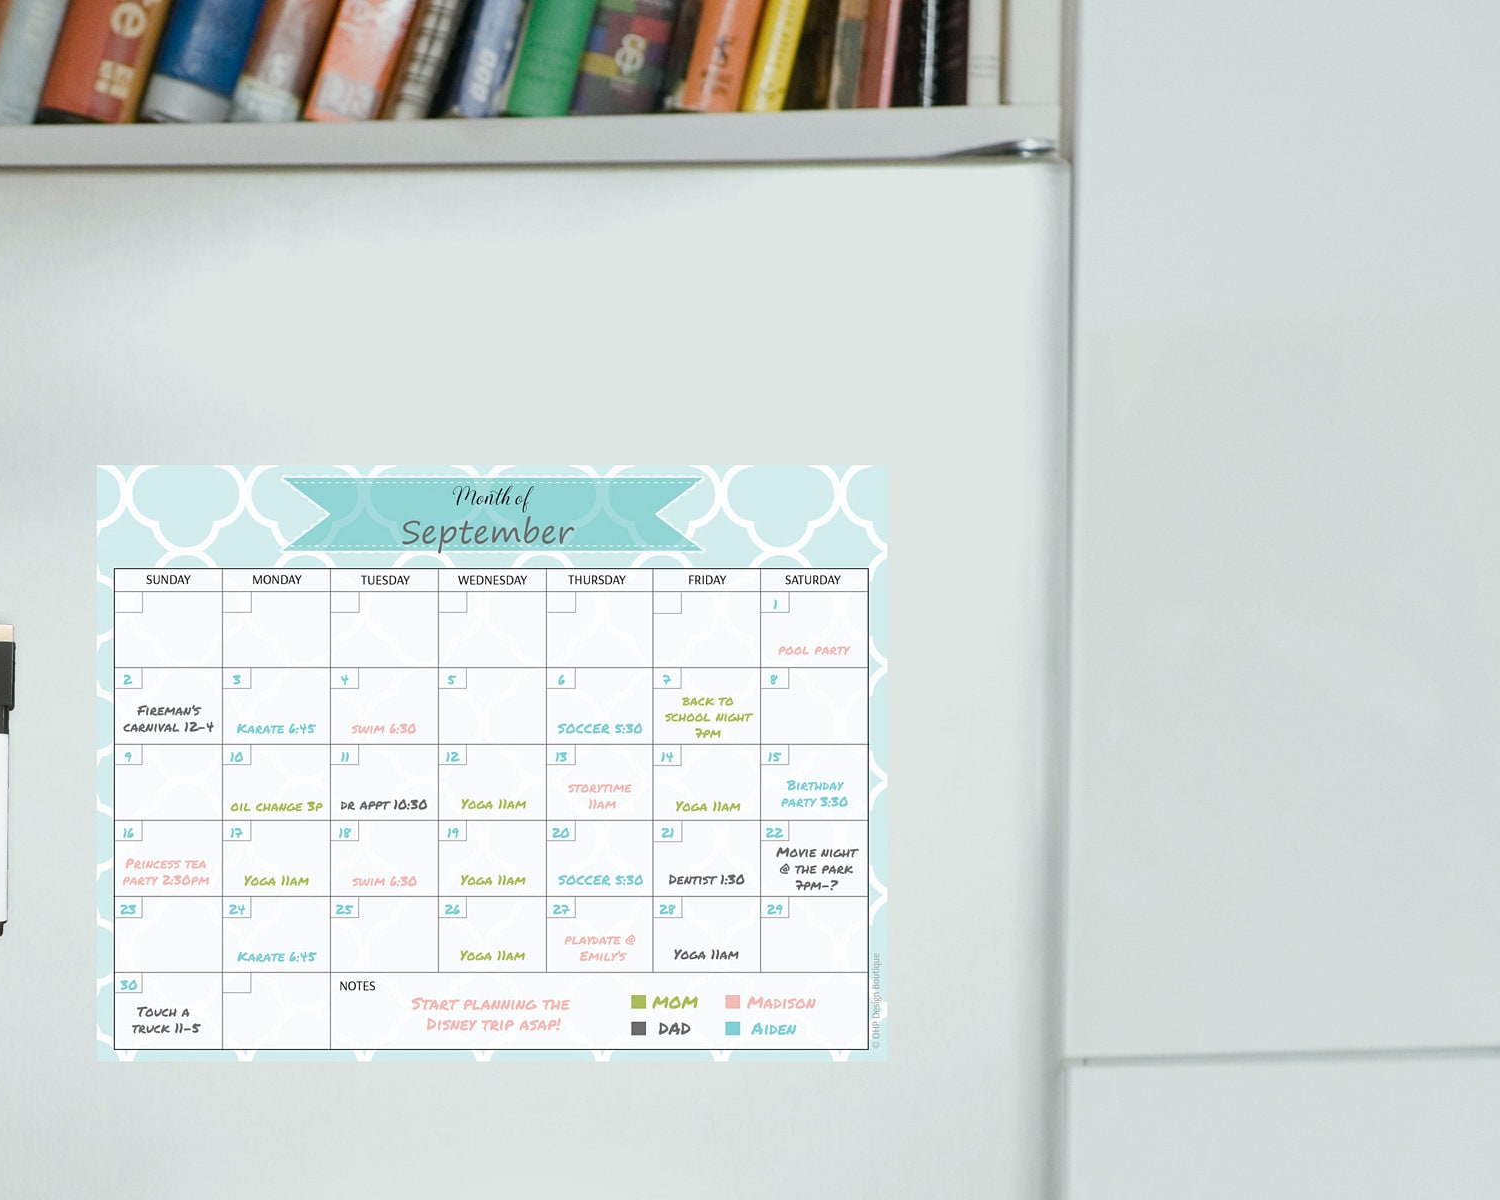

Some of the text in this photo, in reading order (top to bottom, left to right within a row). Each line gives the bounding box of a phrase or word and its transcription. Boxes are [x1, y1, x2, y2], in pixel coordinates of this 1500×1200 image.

[452, 484, 535, 514] Month of
[402, 516, 575, 553] September
[145, 574, 192, 585] SUNDAY
[252, 574, 303, 585] MONDAY
[360, 574, 411, 586] TUESDAY
[457, 574, 528, 586] WEDNESDAY
[567, 574, 627, 586] THURSDAY
[688, 574, 727, 586] FRIDAY
[784, 574, 842, 586] SATURDAY
[778, 646, 851, 656] POOL PARTY
[123, 673, 133, 686] 2
[232, 674, 242, 686] 3
[340, 674, 350, 686] 4
[447, 674, 457, 686] 5
[557, 673, 566, 686] 6
[662, 673, 672, 686] 7
[769, 673, 779, 686] 8
[681, 696, 735, 707] BACK TO
[664, 712, 754, 723] SCHOOL NIGHT
[122, 722, 180, 733] CARNIVAL
[288, 722, 317, 735] 6:45
[351, 723, 417, 735] SWIM 6:30
[557, 722, 644, 735] SOCCER 5:30
[694, 727, 722, 739] 7PM
[124, 751, 133, 763] 9
[229, 751, 244, 763] 10
[340, 751, 350, 763] 11
[445, 751, 461, 763] 12
[555, 751, 568, 763] 13
[660, 751, 675, 763] 14
[767, 751, 783, 763] 15
[567, 783, 632, 794] STORYTIME
[229, 802, 252, 813] OIL
[254, 802, 304, 813] CHANGE
[340, 798, 428, 811] DR APPT 10:30
[497, 798, 527, 810] 11AM
[588, 798, 617, 810] 11AM
[712, 800, 741, 813] 11AM
[780, 795, 849, 808] PARTY 3:30
[122, 827, 135, 839] 16
[229, 827, 244, 839] 17
[338, 827, 352, 839] 18
[446, 827, 460, 839] 19
[551, 826, 571, 839] 20
[661, 827, 675, 839] 21
[765, 827, 785, 839] 22
[820, 848, 860, 859] NIGHT
[184, 859, 207, 869] TEA
[779, 862, 854, 875] @ THE PARK
[122, 874, 210, 886] PARTY 2:30PM
[280, 874, 310, 887] 11AM
[352, 875, 417, 887] SWIM 6:30
[497, 874, 527, 886] 11AM
[557, 873, 644, 887] SOCCER 5:30
[719, 873, 746, 886] 1:30
[119, 903, 137, 916] 23
[228, 903, 246, 916] 24
[335, 903, 354, 916] 25
[444, 903, 461, 916] 26
[552, 903, 571, 916] 27
[659, 903, 677, 916] 28
[766, 903, 784, 916] 29
[564, 934, 636, 946] PLAYDATE @
[288, 951, 318, 963] 6:45
[496, 949, 526, 962] 11AM
[710, 948, 740, 961] 11AM
[871, 952, 883, 991] Boutique
[119, 979, 138, 991] 30
[339, 980, 376, 992] NOTES
[463, 999, 538, 1011] PLANNING
[542, 999, 571, 1011] THE
[651, 995, 699, 1010] MOM
[871, 991, 883, 1020] Design
[181, 1007, 191, 1018] A
[131, 1024, 171, 1035] TRUCK
[481, 1019, 515, 1032] TRIP
[519, 1017, 562, 1031] ASAP!
[658, 1021, 692, 1036] DAD
[871, 1020, 881, 1040] OHP
